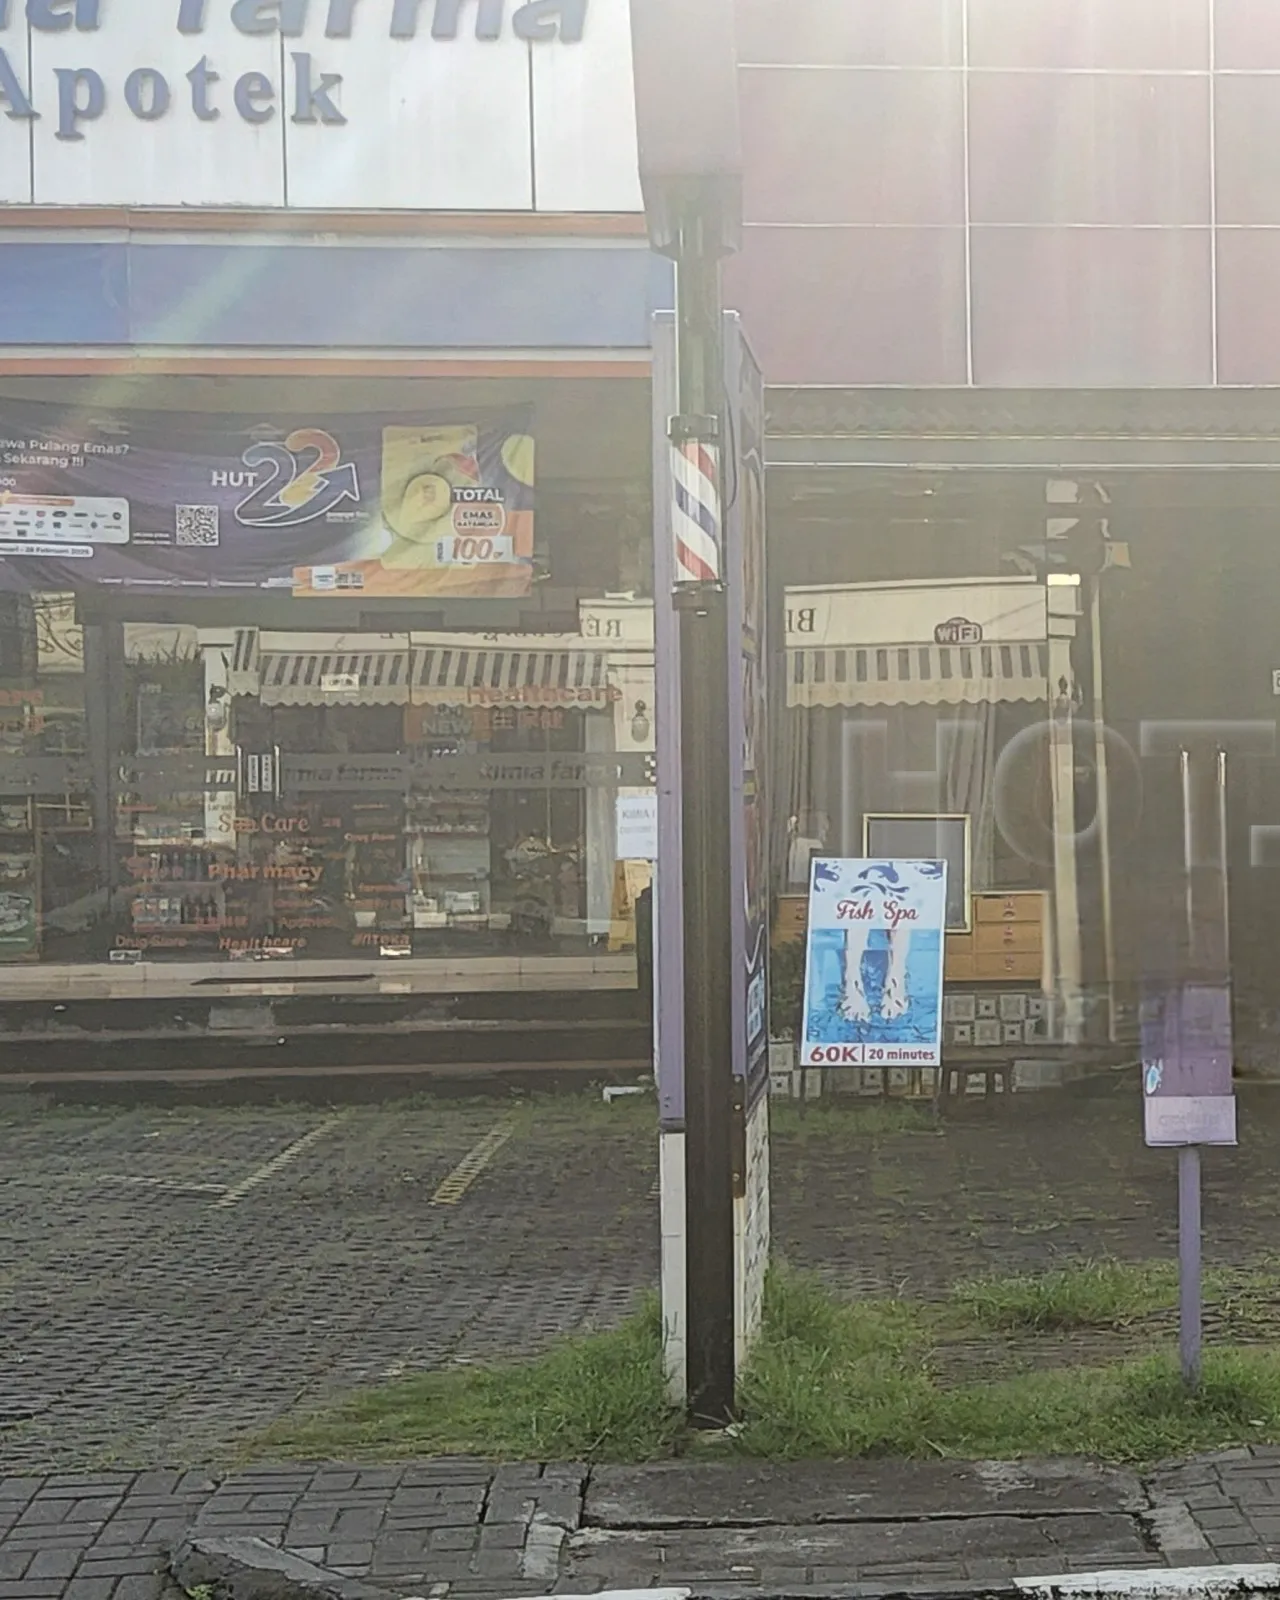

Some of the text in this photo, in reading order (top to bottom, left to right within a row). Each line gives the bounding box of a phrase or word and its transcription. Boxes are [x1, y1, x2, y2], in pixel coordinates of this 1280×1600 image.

[30, 440, 80, 454] Pulang
[84, 442, 130, 454] Emas?
[3, 453, 69, 468] Sekarang
[211, 471, 258, 487] HUT
[453, 488, 504, 501] TOTAL
[463, 511, 493, 519] EMAS
[452, 537, 493, 560] 100
[467, 683, 623, 703] Healthcare
[262, 813, 311, 834] Care
[836, 899, 919, 927] Fish Spa
[810, 1046, 859, 1062] 60K
[869, 1048, 884, 1060] 20
[887, 1047, 936, 1060] minutes
